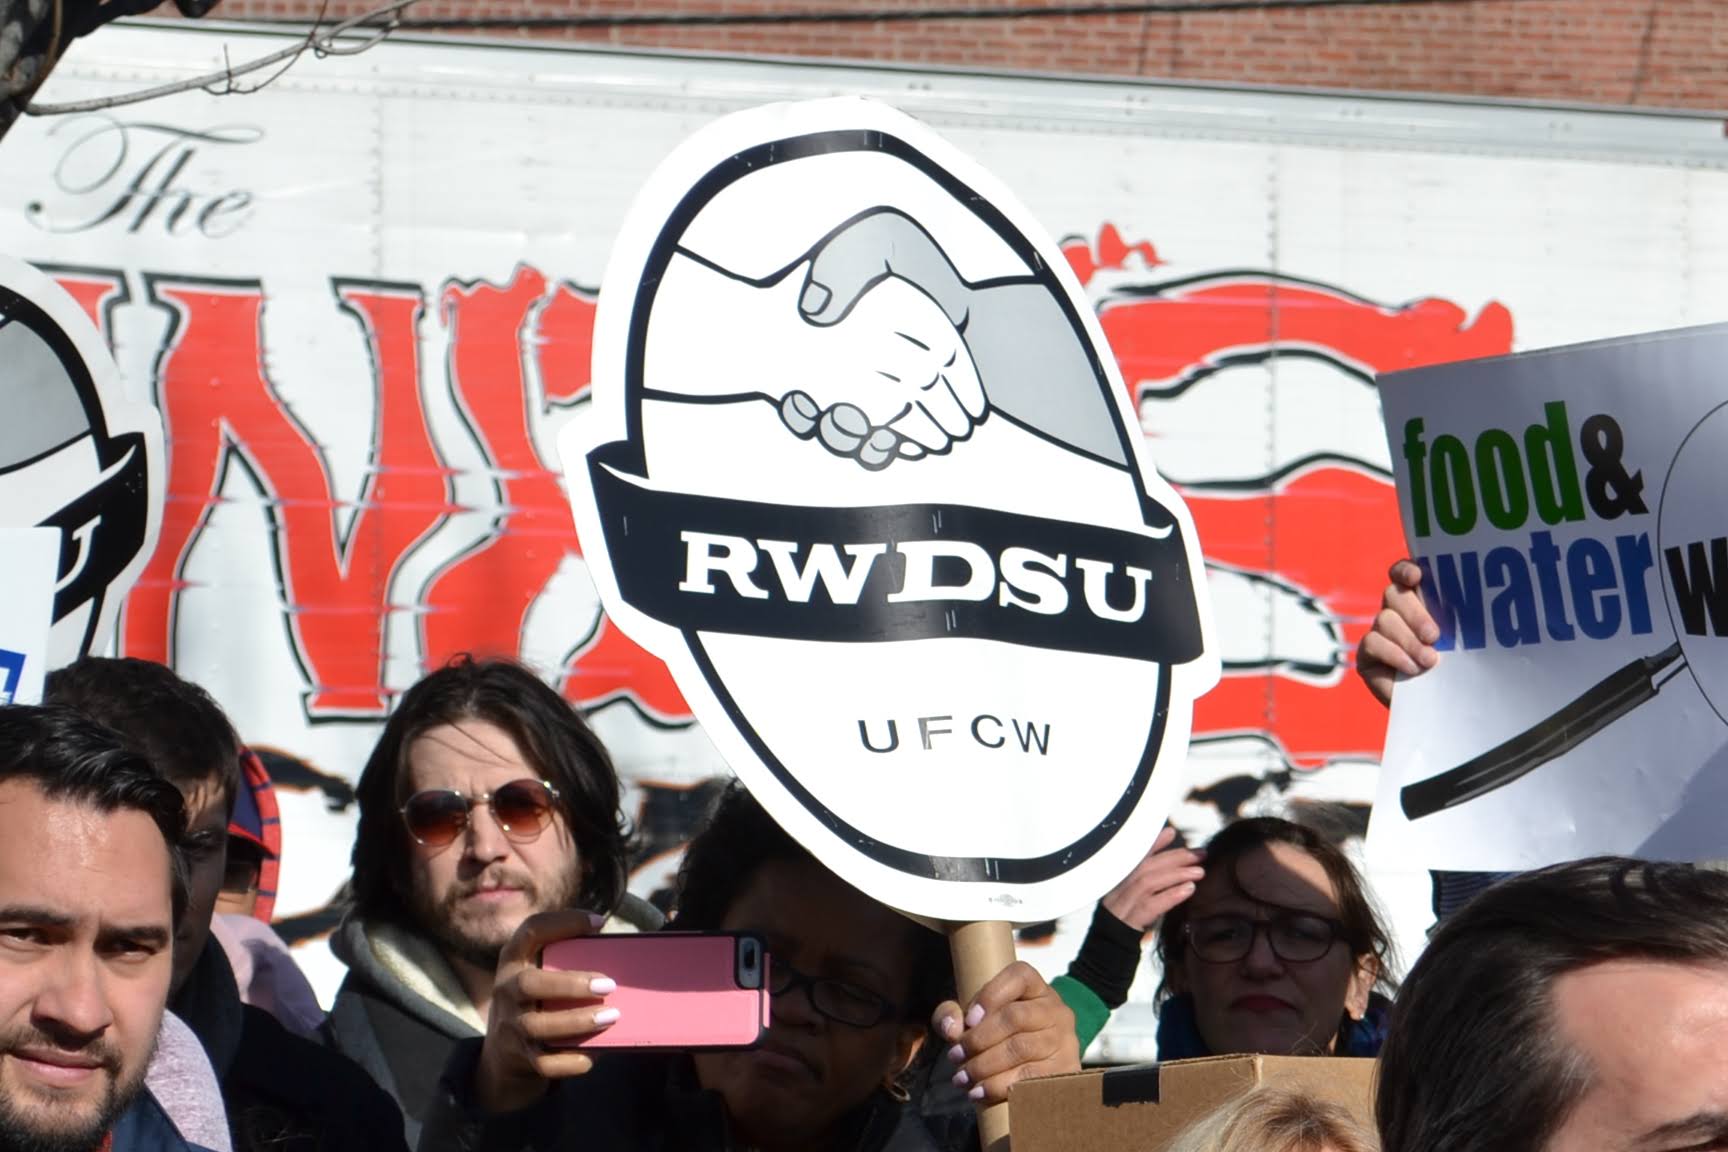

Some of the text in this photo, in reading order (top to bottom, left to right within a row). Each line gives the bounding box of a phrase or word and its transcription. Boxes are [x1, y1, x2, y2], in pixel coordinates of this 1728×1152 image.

[24, 113, 264, 239] The
[678, 530, 1153, 623] RWDSU
[1417, 530, 1654, 652] water
[858, 714, 1051, 756] UFCW
